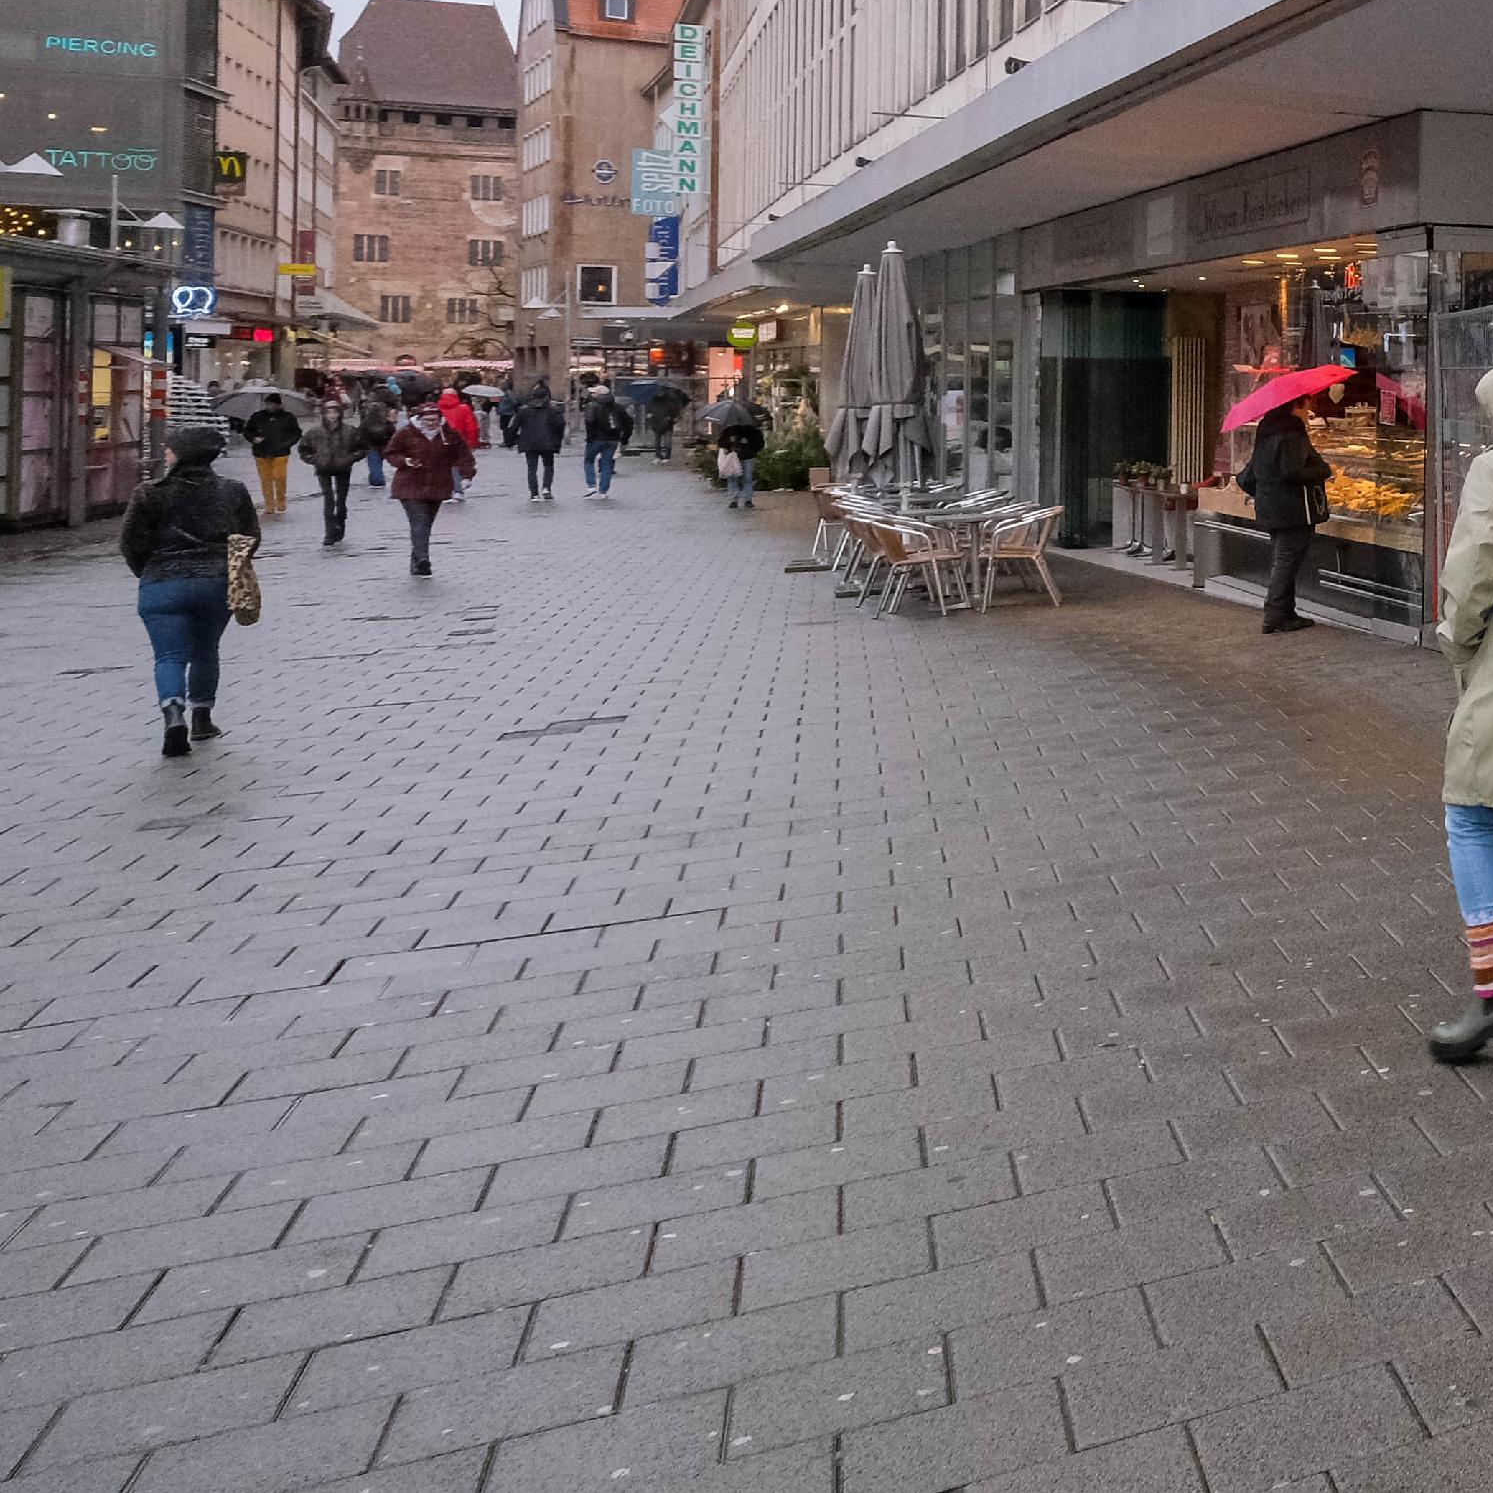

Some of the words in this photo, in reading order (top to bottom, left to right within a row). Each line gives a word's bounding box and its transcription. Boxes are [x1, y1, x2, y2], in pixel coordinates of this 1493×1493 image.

[46, 35, 157, 57] PIERCING
[678, 25, 699, 193] DEICHMANN
[44, 148, 158, 171] TATTOO
[632, 198, 675, 214] FOTO
